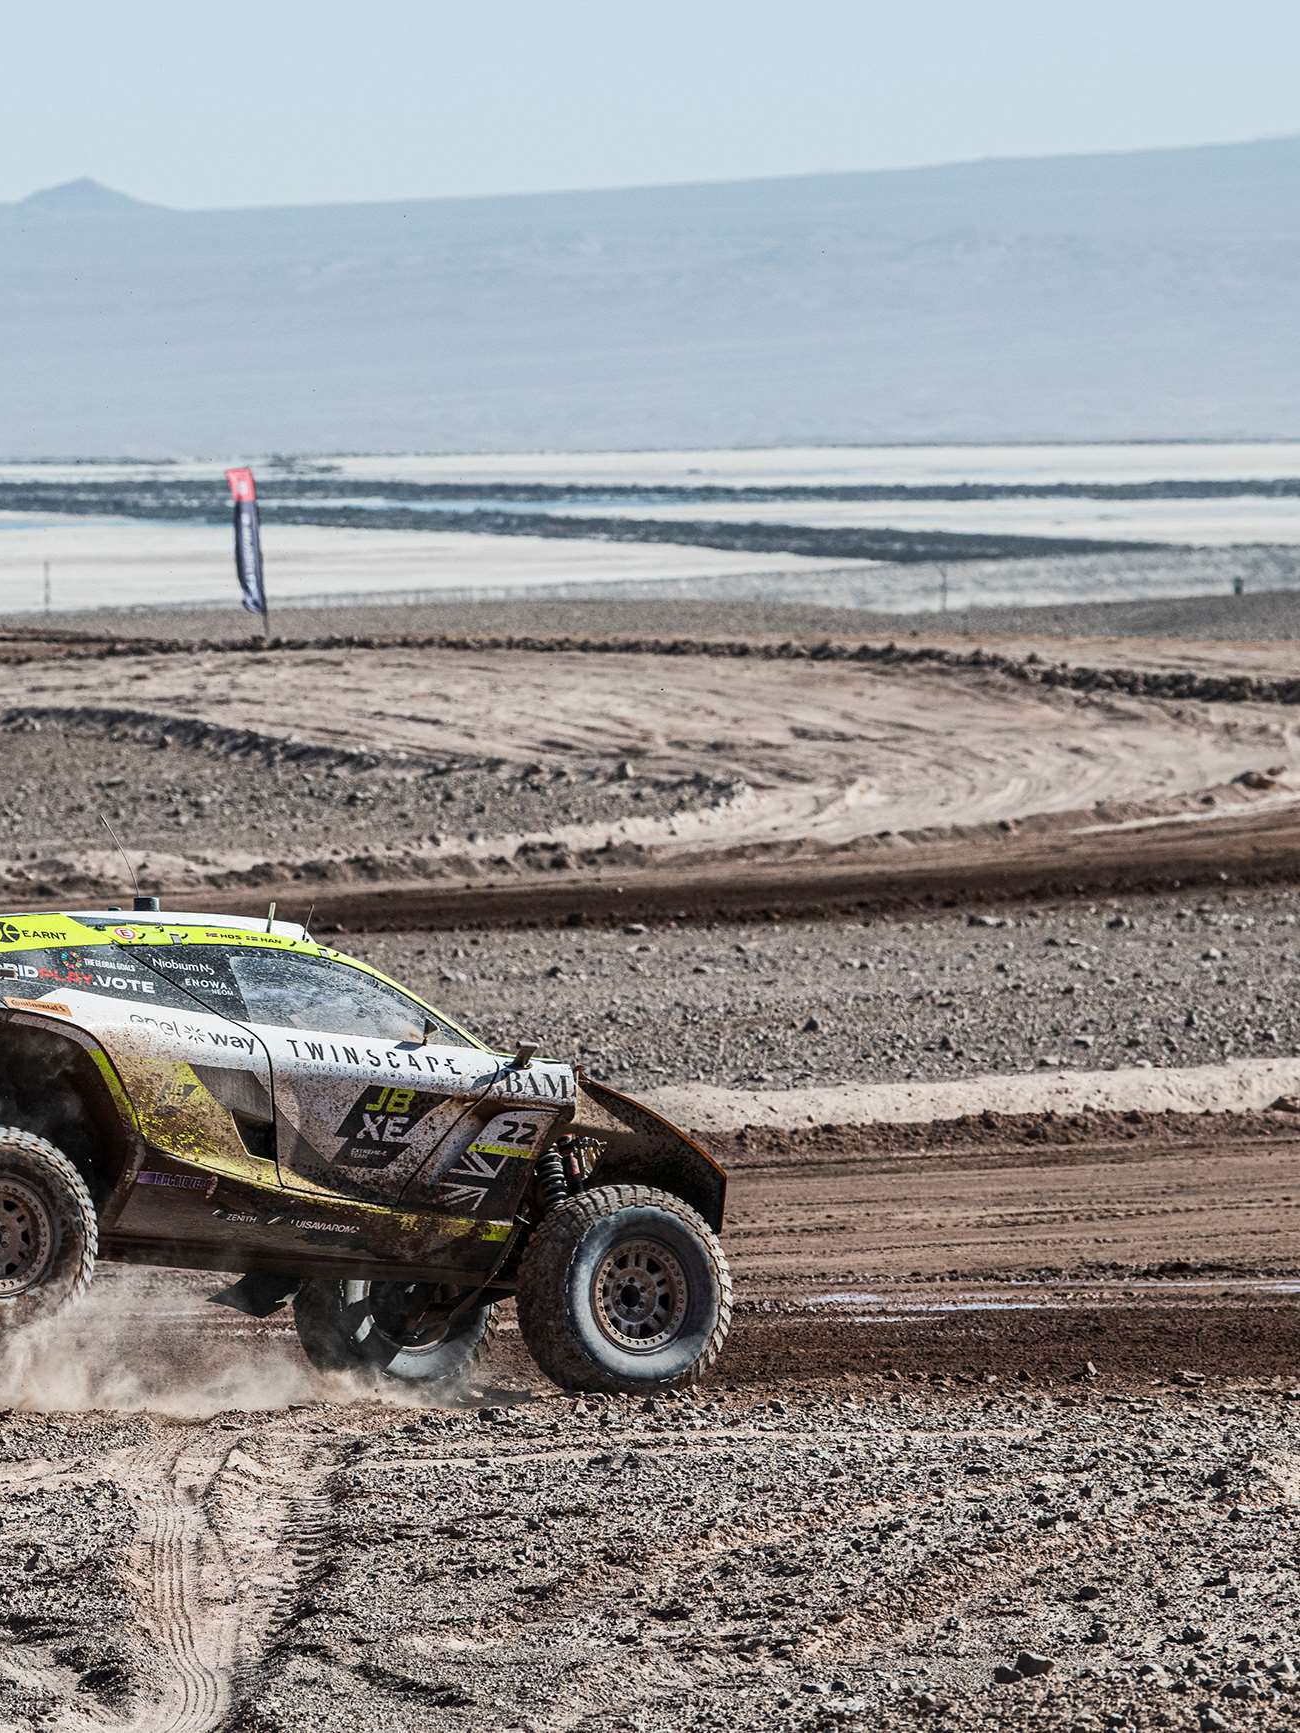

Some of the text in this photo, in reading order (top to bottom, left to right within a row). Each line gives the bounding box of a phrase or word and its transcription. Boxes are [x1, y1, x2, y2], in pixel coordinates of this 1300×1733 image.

[22, 930, 67, 941] EARNT
[207, 1032, 254, 1055] way
[286, 1039, 462, 1075] TWINSCAPE
[364, 1087, 416, 1113] JB
[356, 1113, 410, 1141] XE
[497, 1120, 538, 1145] 22
[226, 1213, 257, 1224] ZENITH
